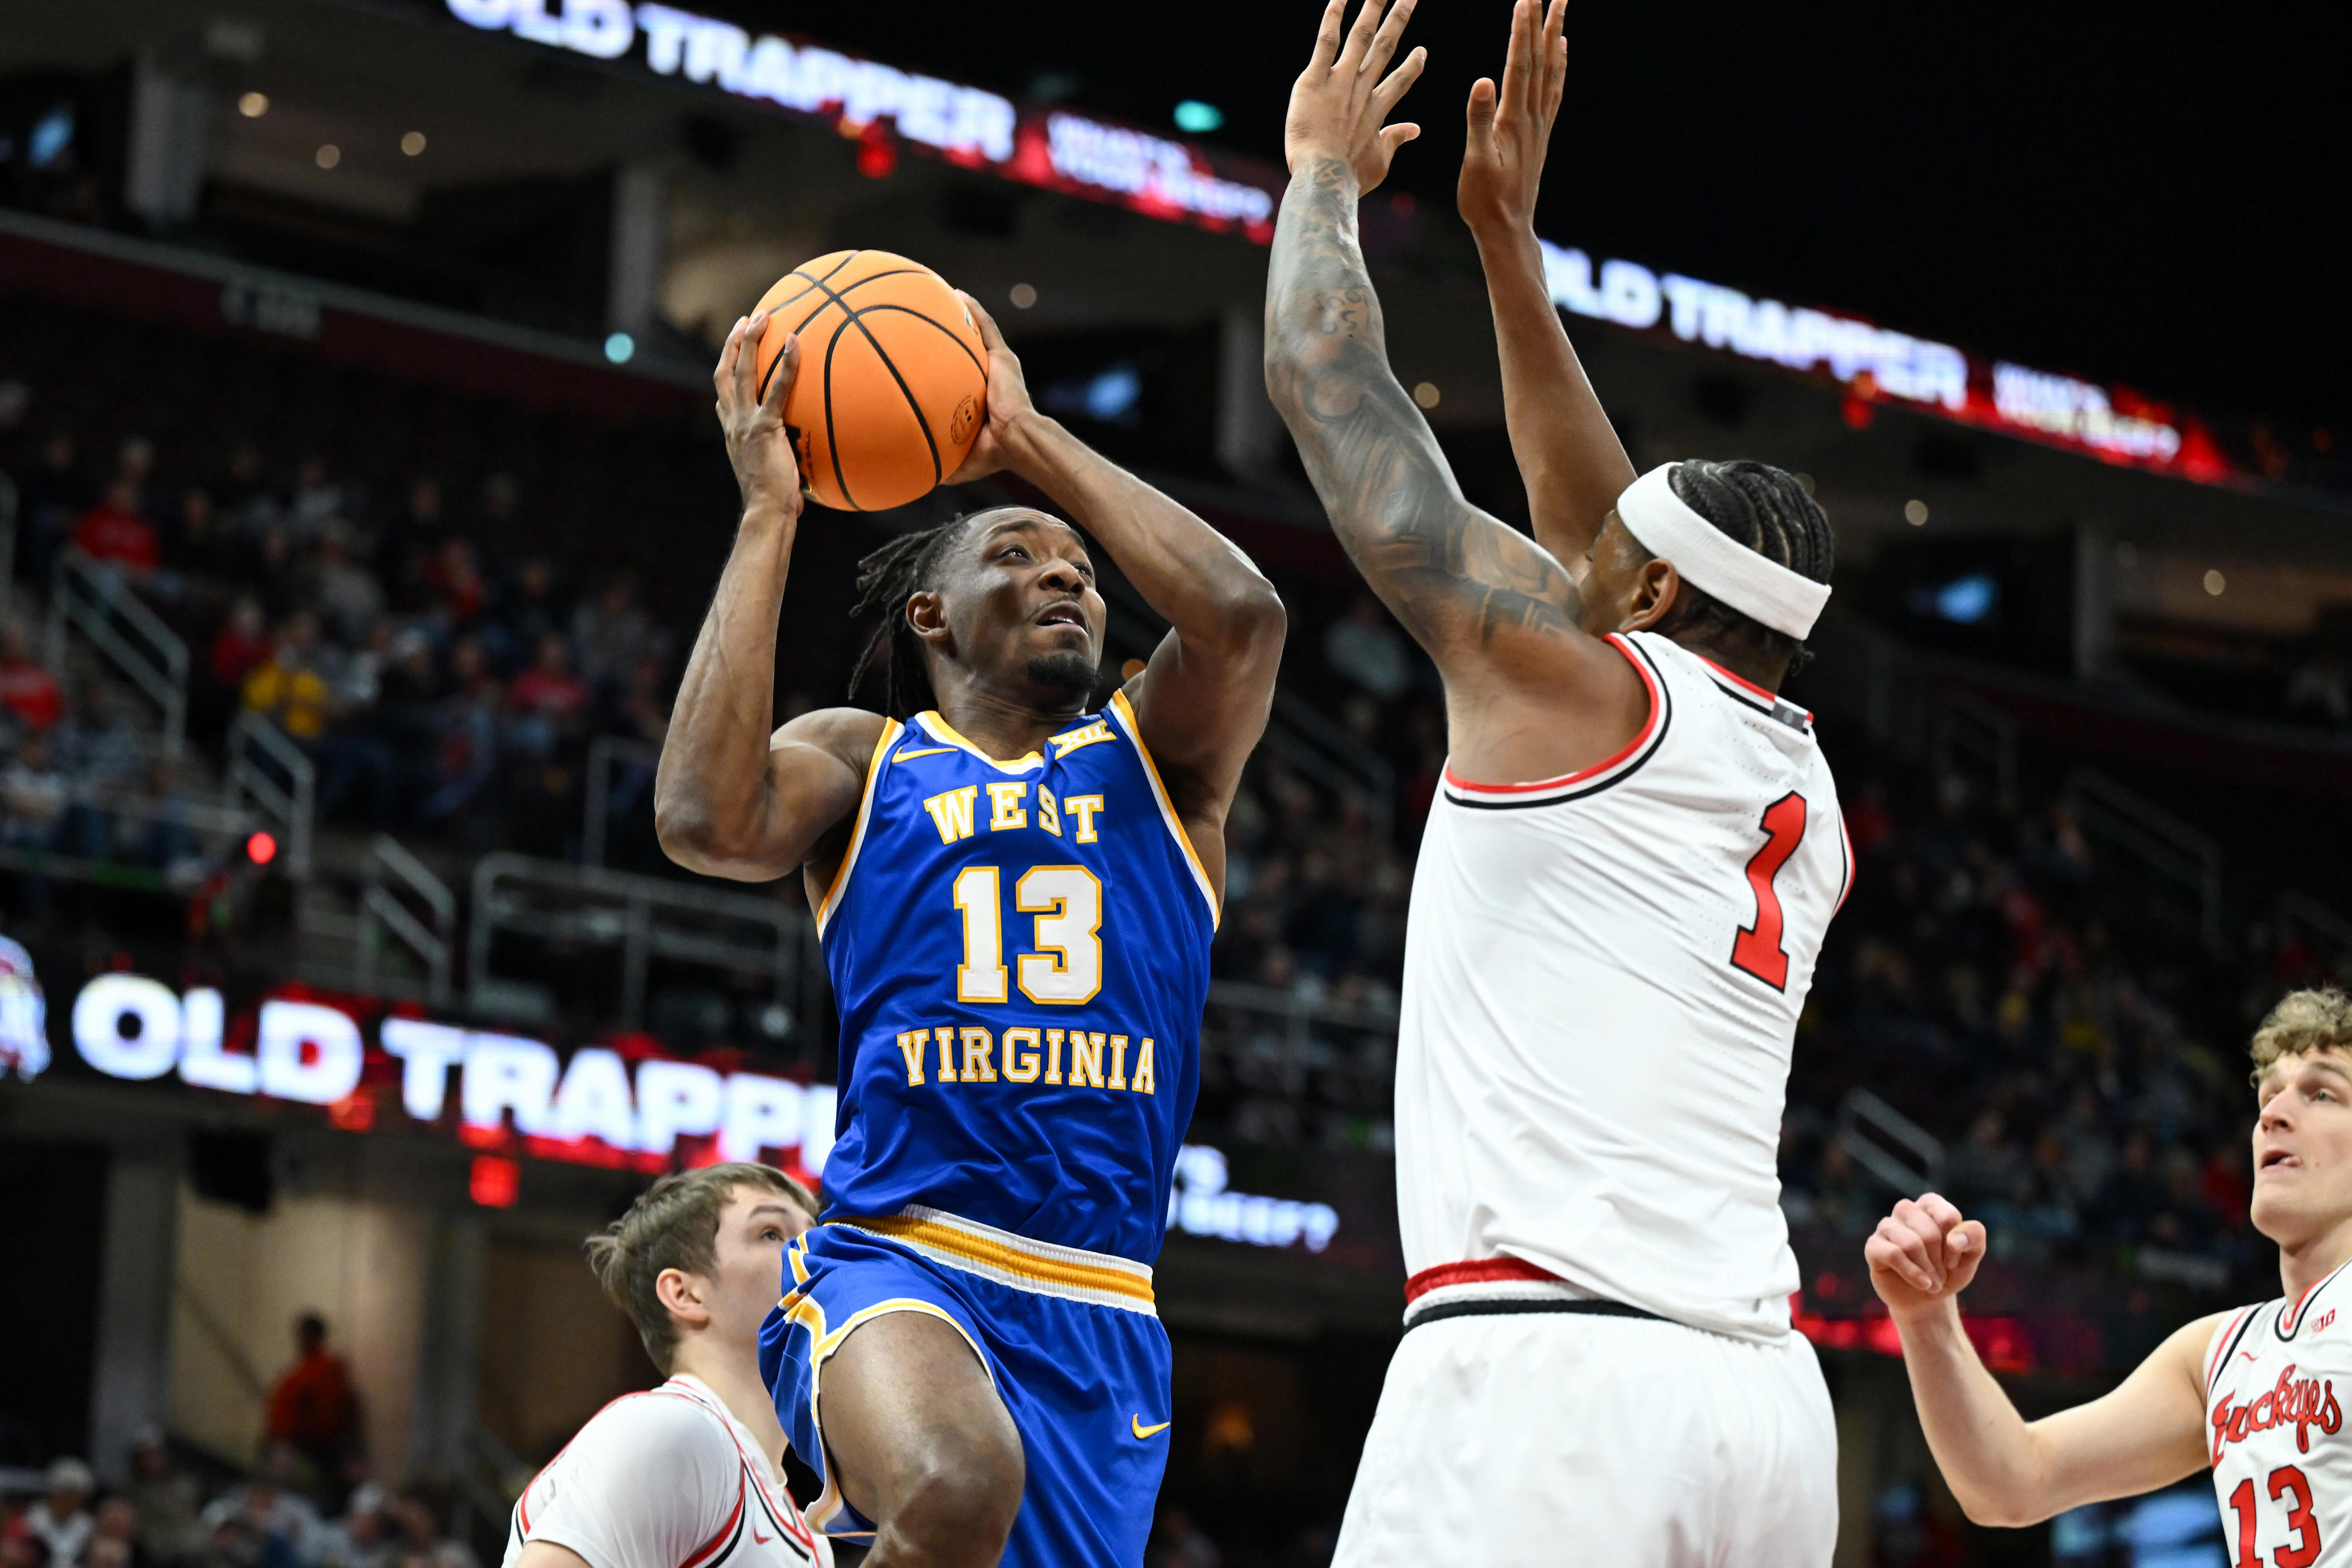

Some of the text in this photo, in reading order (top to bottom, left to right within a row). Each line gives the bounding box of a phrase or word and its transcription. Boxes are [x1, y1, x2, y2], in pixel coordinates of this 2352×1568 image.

[635, 2, 1016, 163] TRAPPER
[1660, 272, 1968, 412] TRAPPER
[924, 782, 1104, 844] WEST
[953, 865, 1102, 1005] 13
[1730, 790, 1807, 994] 1
[72, 973, 363, 1105] OLD
[897, 1027, 1155, 1095] VIRGINIA
[2230, 1464, 2322, 1568] 13
